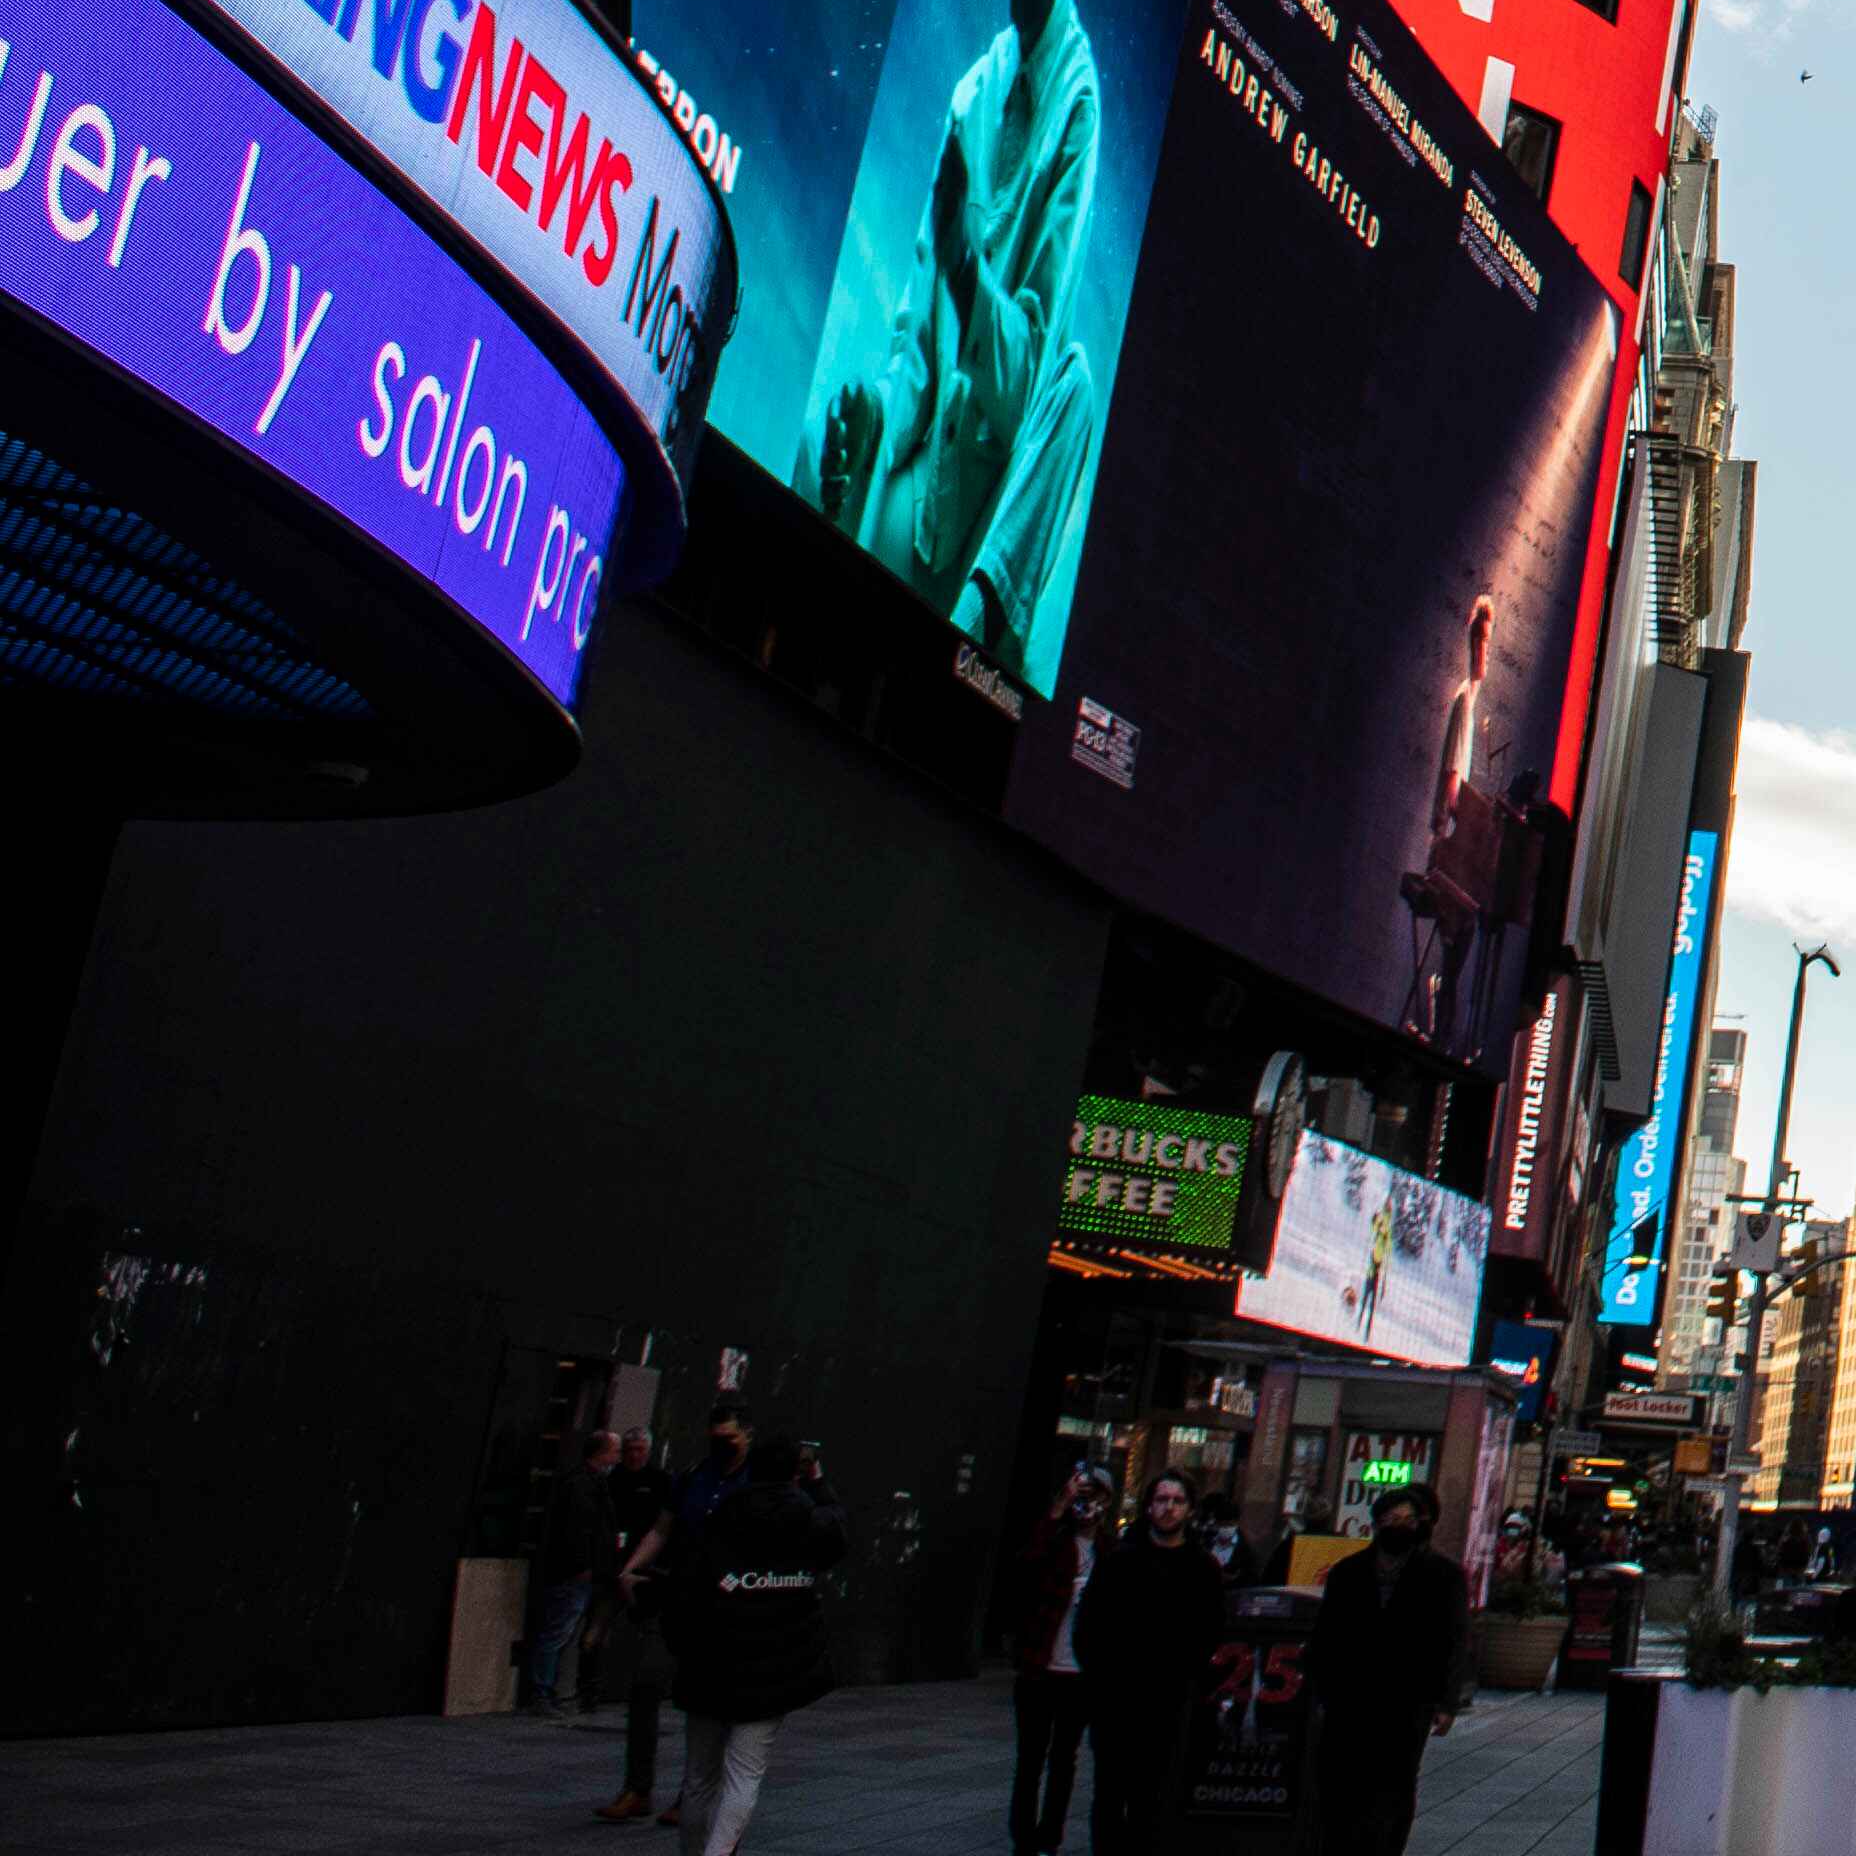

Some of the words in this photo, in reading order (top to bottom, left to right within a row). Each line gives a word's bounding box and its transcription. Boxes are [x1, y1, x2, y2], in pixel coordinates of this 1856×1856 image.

[1200, 29, 1289, 144] ANDREW
[1292, 133, 1382, 249] GARFIELD
[1350, 43, 1410, 134] LIN-MANUEL
[1410, 120, 1454, 188] MIRANDA
[205, 140, 333, 434] by
[358, 338, 533, 569] salon
[1068, 1169, 1178, 1217] FFEE
[1643, 1397, 1689, 1415] Locker
[1350, 1433, 1428, 1465] ATM
[1362, 1460, 1412, 1485] ATM
[1209, 1640, 1307, 1704] 25
[1192, 1784, 1290, 1805] CHICAGO
